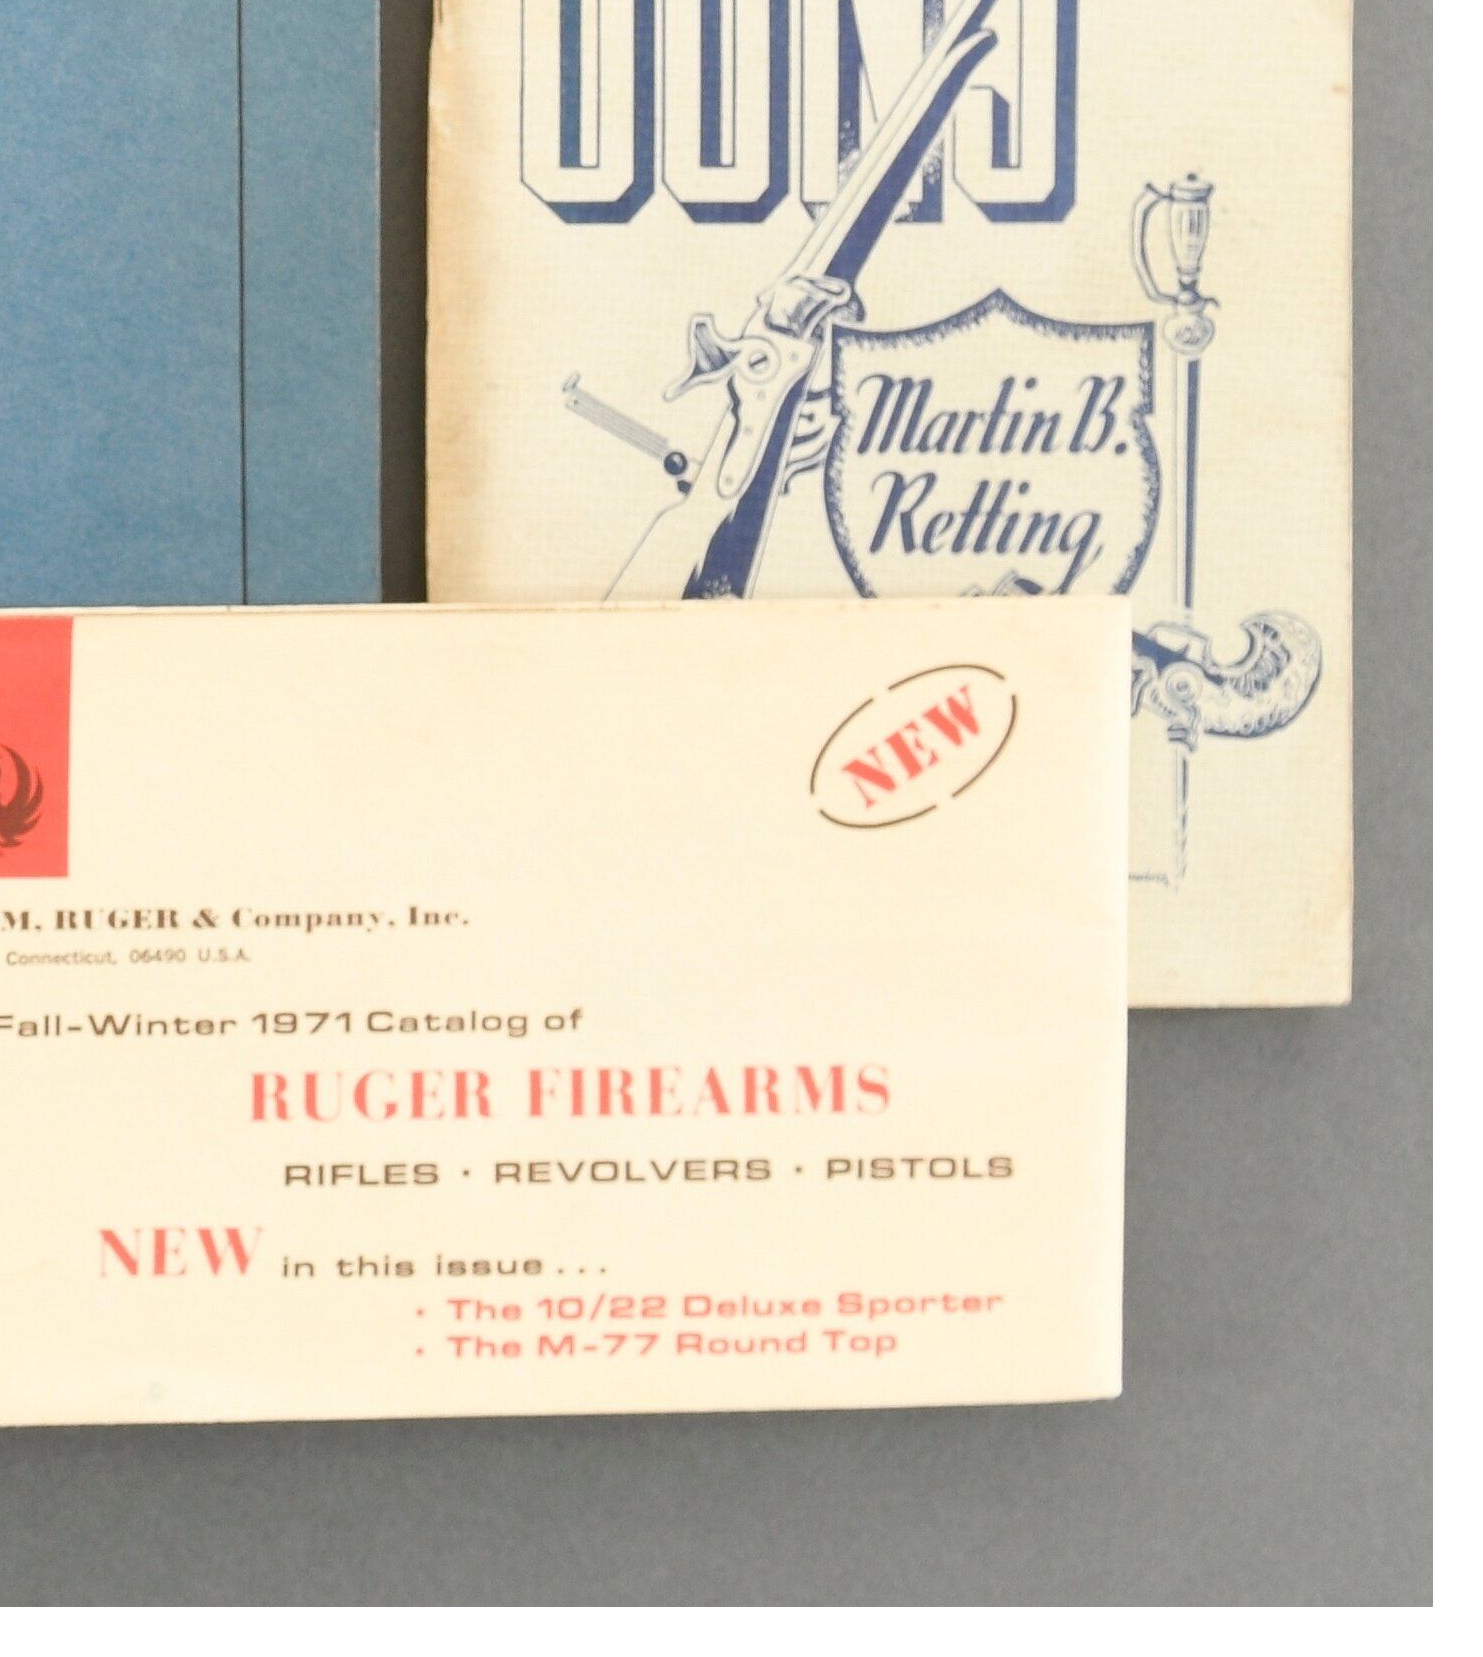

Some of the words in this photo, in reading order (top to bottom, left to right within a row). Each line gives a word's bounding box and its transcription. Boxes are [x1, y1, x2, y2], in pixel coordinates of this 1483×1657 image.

[857, 374, 1061, 455] Martin
[1068, 374, 1127, 455] B.
[868, 471, 1102, 596] Retting
[842, 684, 982, 809] NEW
[55, 909, 178, 930] RUGER
[193, 909, 218, 929] &
[232, 906, 394, 932] Company,
[408, 906, 469, 928] Inc.
[6, 951, 116, 966] Connecticut,
[130, 949, 186, 963] 06490
[251, 1012, 352, 1035] 1971
[367, 1011, 528, 1037] Catalog
[543, 1009, 583, 1032] of
[250, 1070, 494, 1123] RUGER
[527, 1064, 892, 1119] FIREARMS
[285, 1162, 439, 1188] RIFLES
[494, 1159, 772, 1185] REVOLVERS
[826, 1156, 1014, 1182] PISTOLS
[97, 1226, 264, 1278] NEW
[281, 1254, 316, 1278] in
[336, 1254, 415, 1278] this
[447, 1298, 522, 1323] The
[536, 1295, 668, 1322] 10/22
[683, 1293, 822, 1320] Deluxe
[837, 1289, 1004, 1320] Sporter
[447, 1335, 522, 1360] The
[536, 1332, 661, 1359] M-77
[675, 1330, 809, 1356] Round
[823, 1329, 898, 1359] Top
